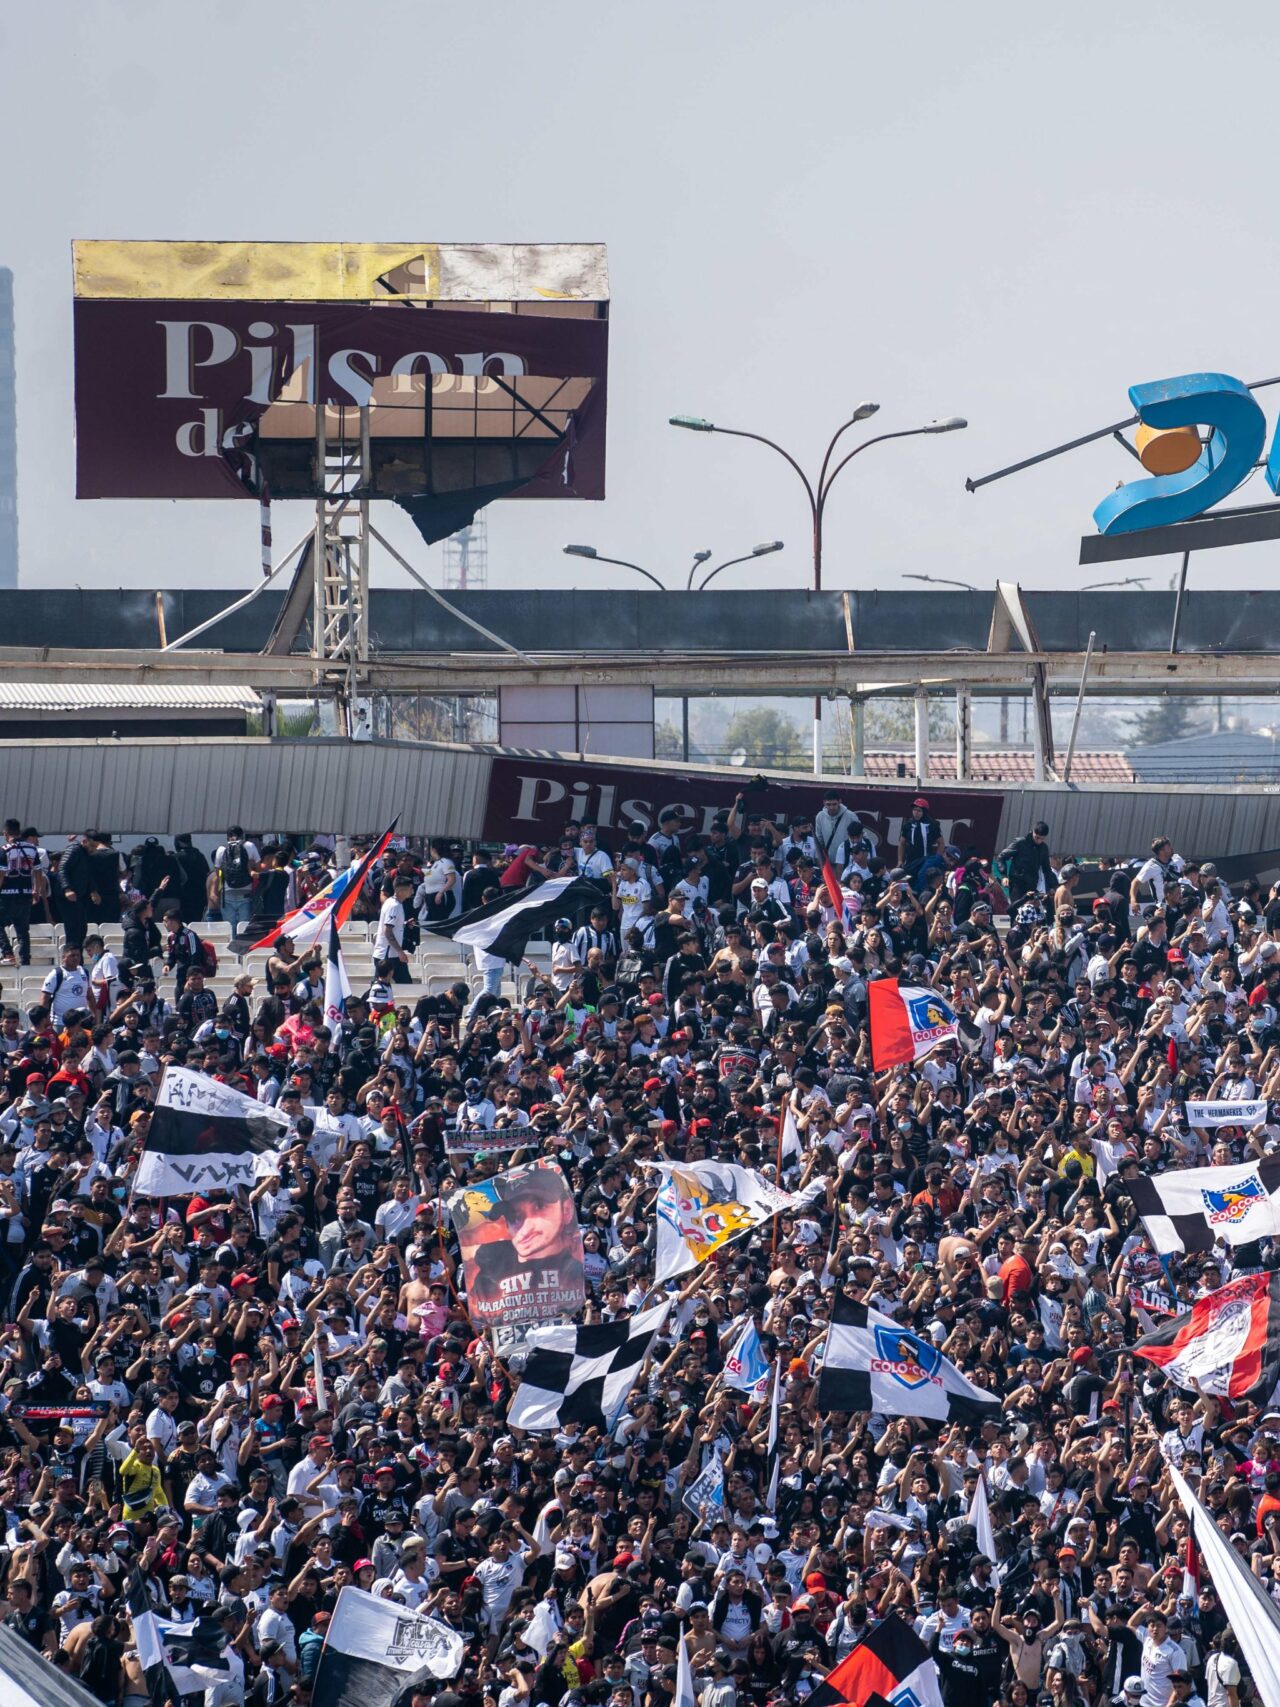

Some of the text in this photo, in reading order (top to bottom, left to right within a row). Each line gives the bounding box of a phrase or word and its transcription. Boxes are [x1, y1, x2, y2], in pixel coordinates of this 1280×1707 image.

[1194, 1109, 1204, 1118] THE
[1210, 1206, 1239, 1223] COLO
[1142, 1286, 1169, 1312] LOS
